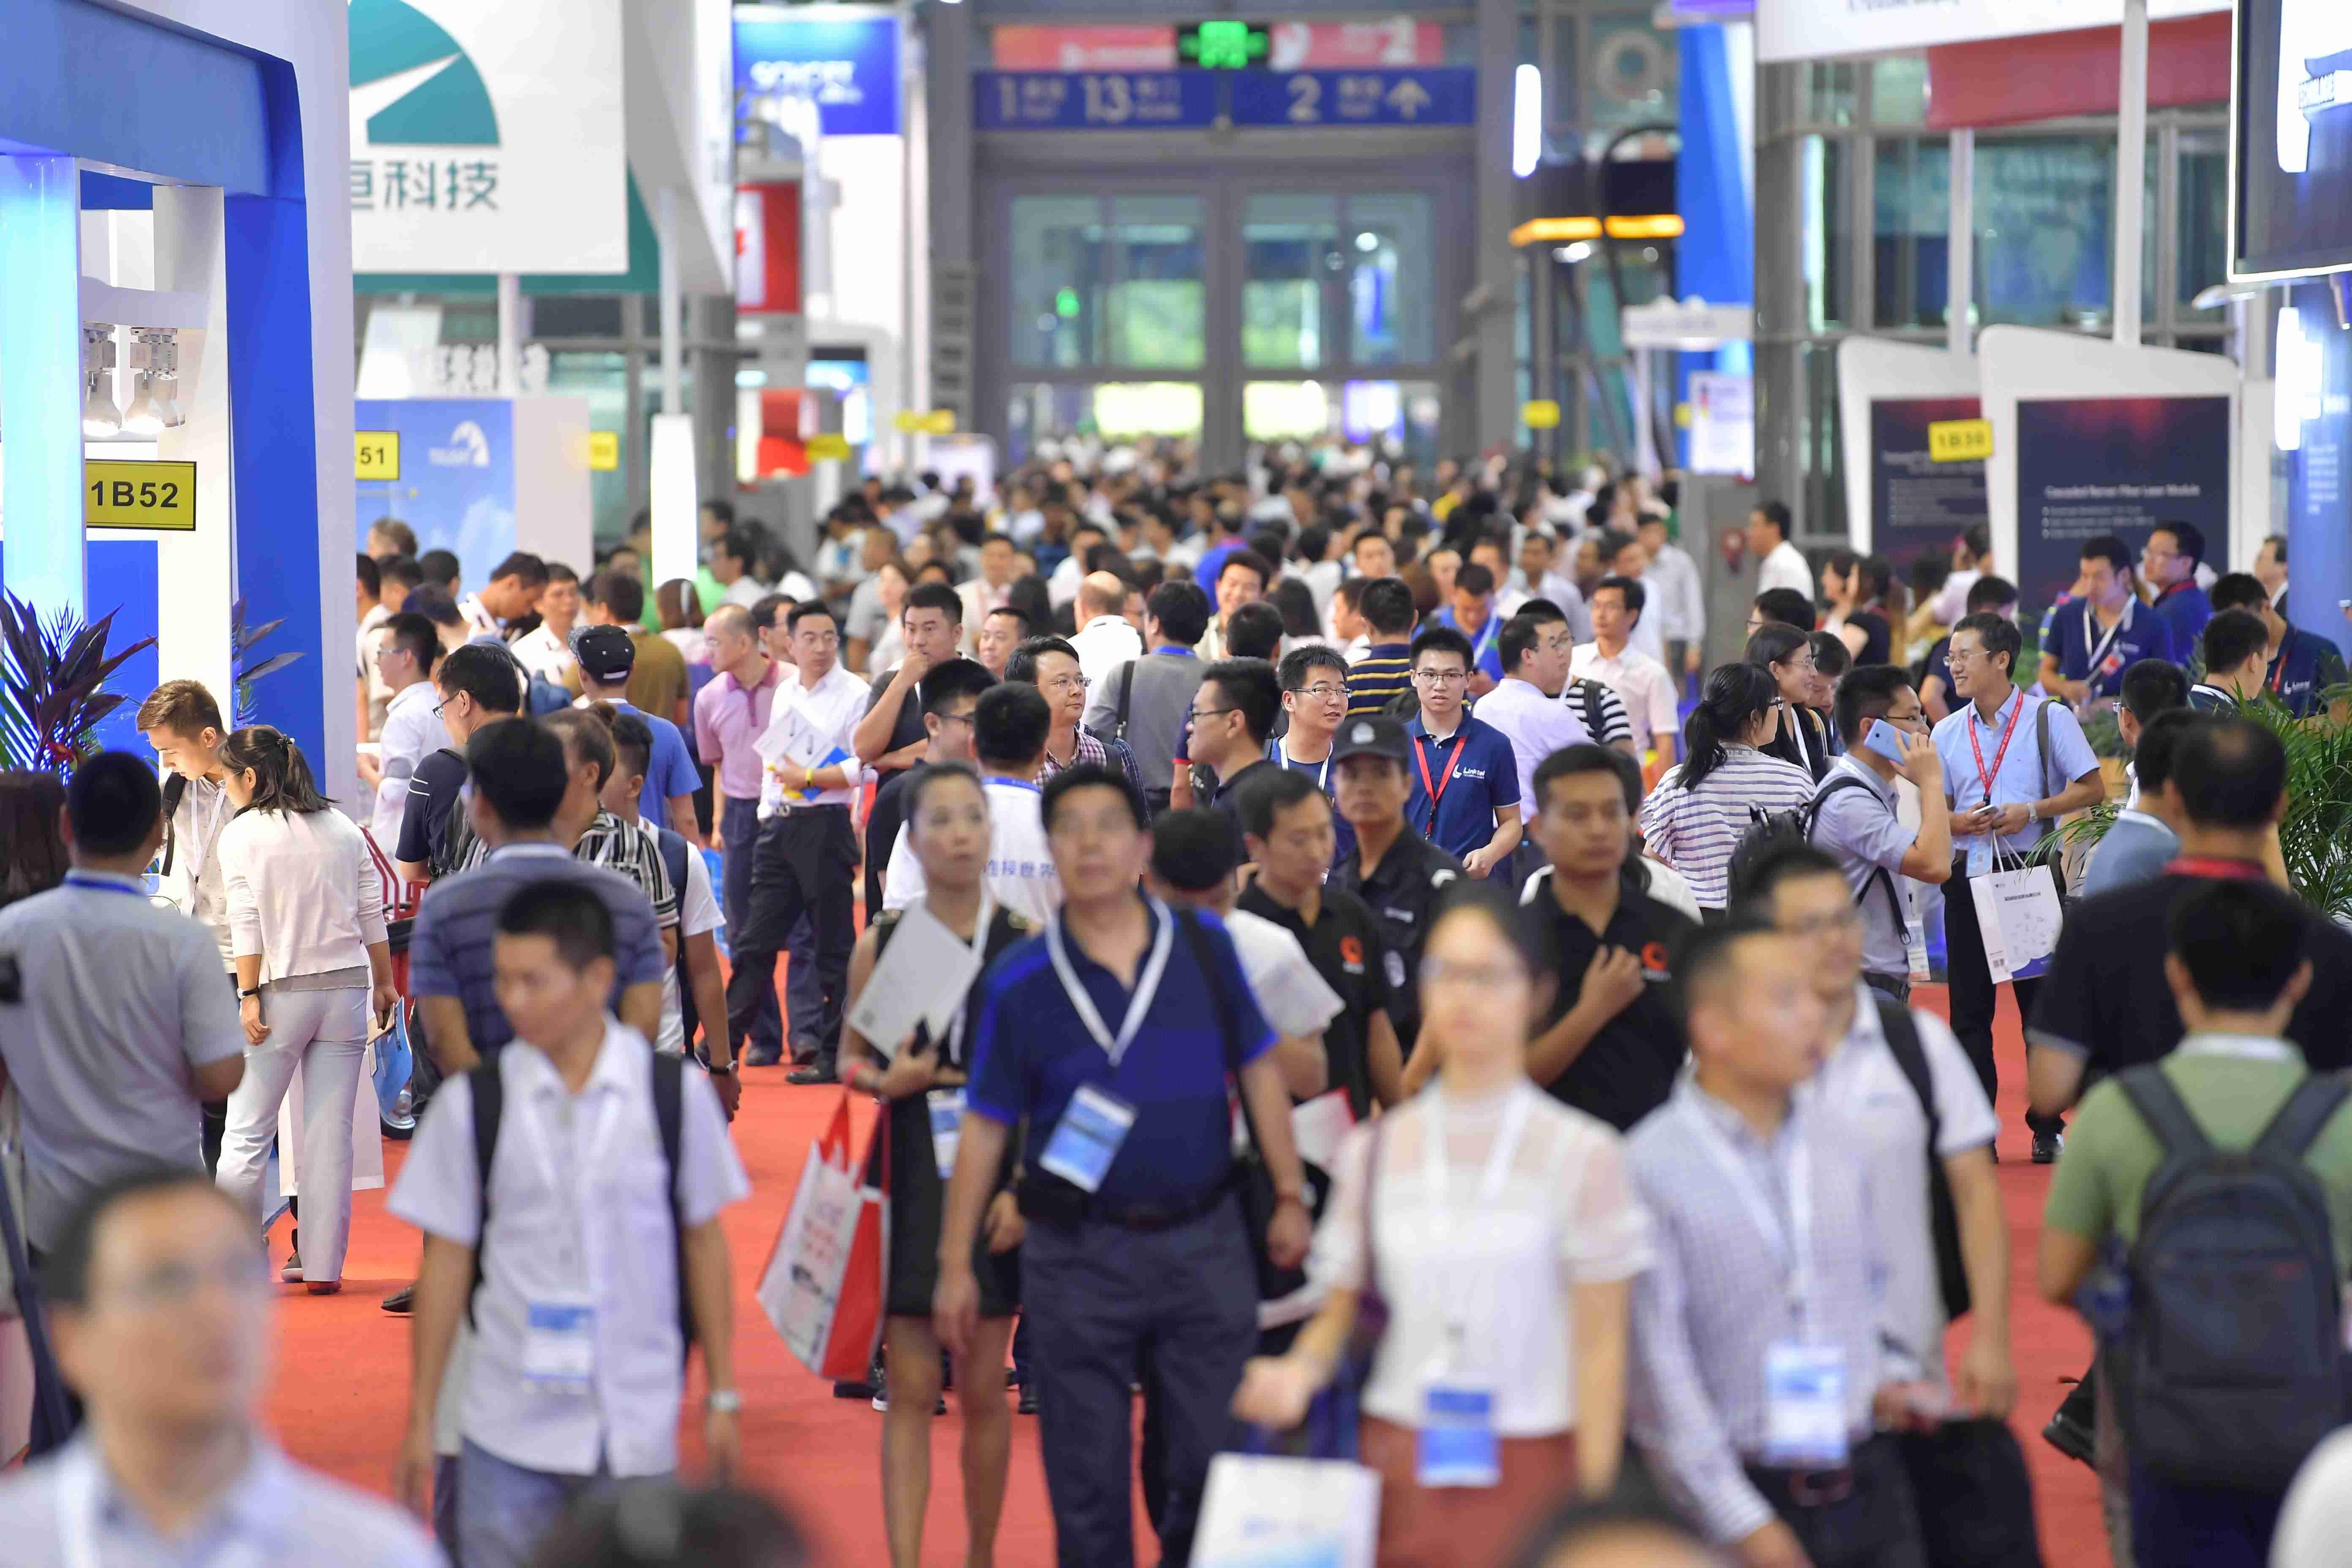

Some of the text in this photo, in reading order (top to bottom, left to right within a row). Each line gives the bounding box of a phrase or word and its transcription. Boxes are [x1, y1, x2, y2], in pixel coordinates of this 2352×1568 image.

[1082, 75, 1132, 122] 13
[1287, 75, 1321, 121] 2
[355, 446, 384, 465] 51
[90, 481, 179, 509] 1B52
[1463, 767, 1485, 776] Linktel
